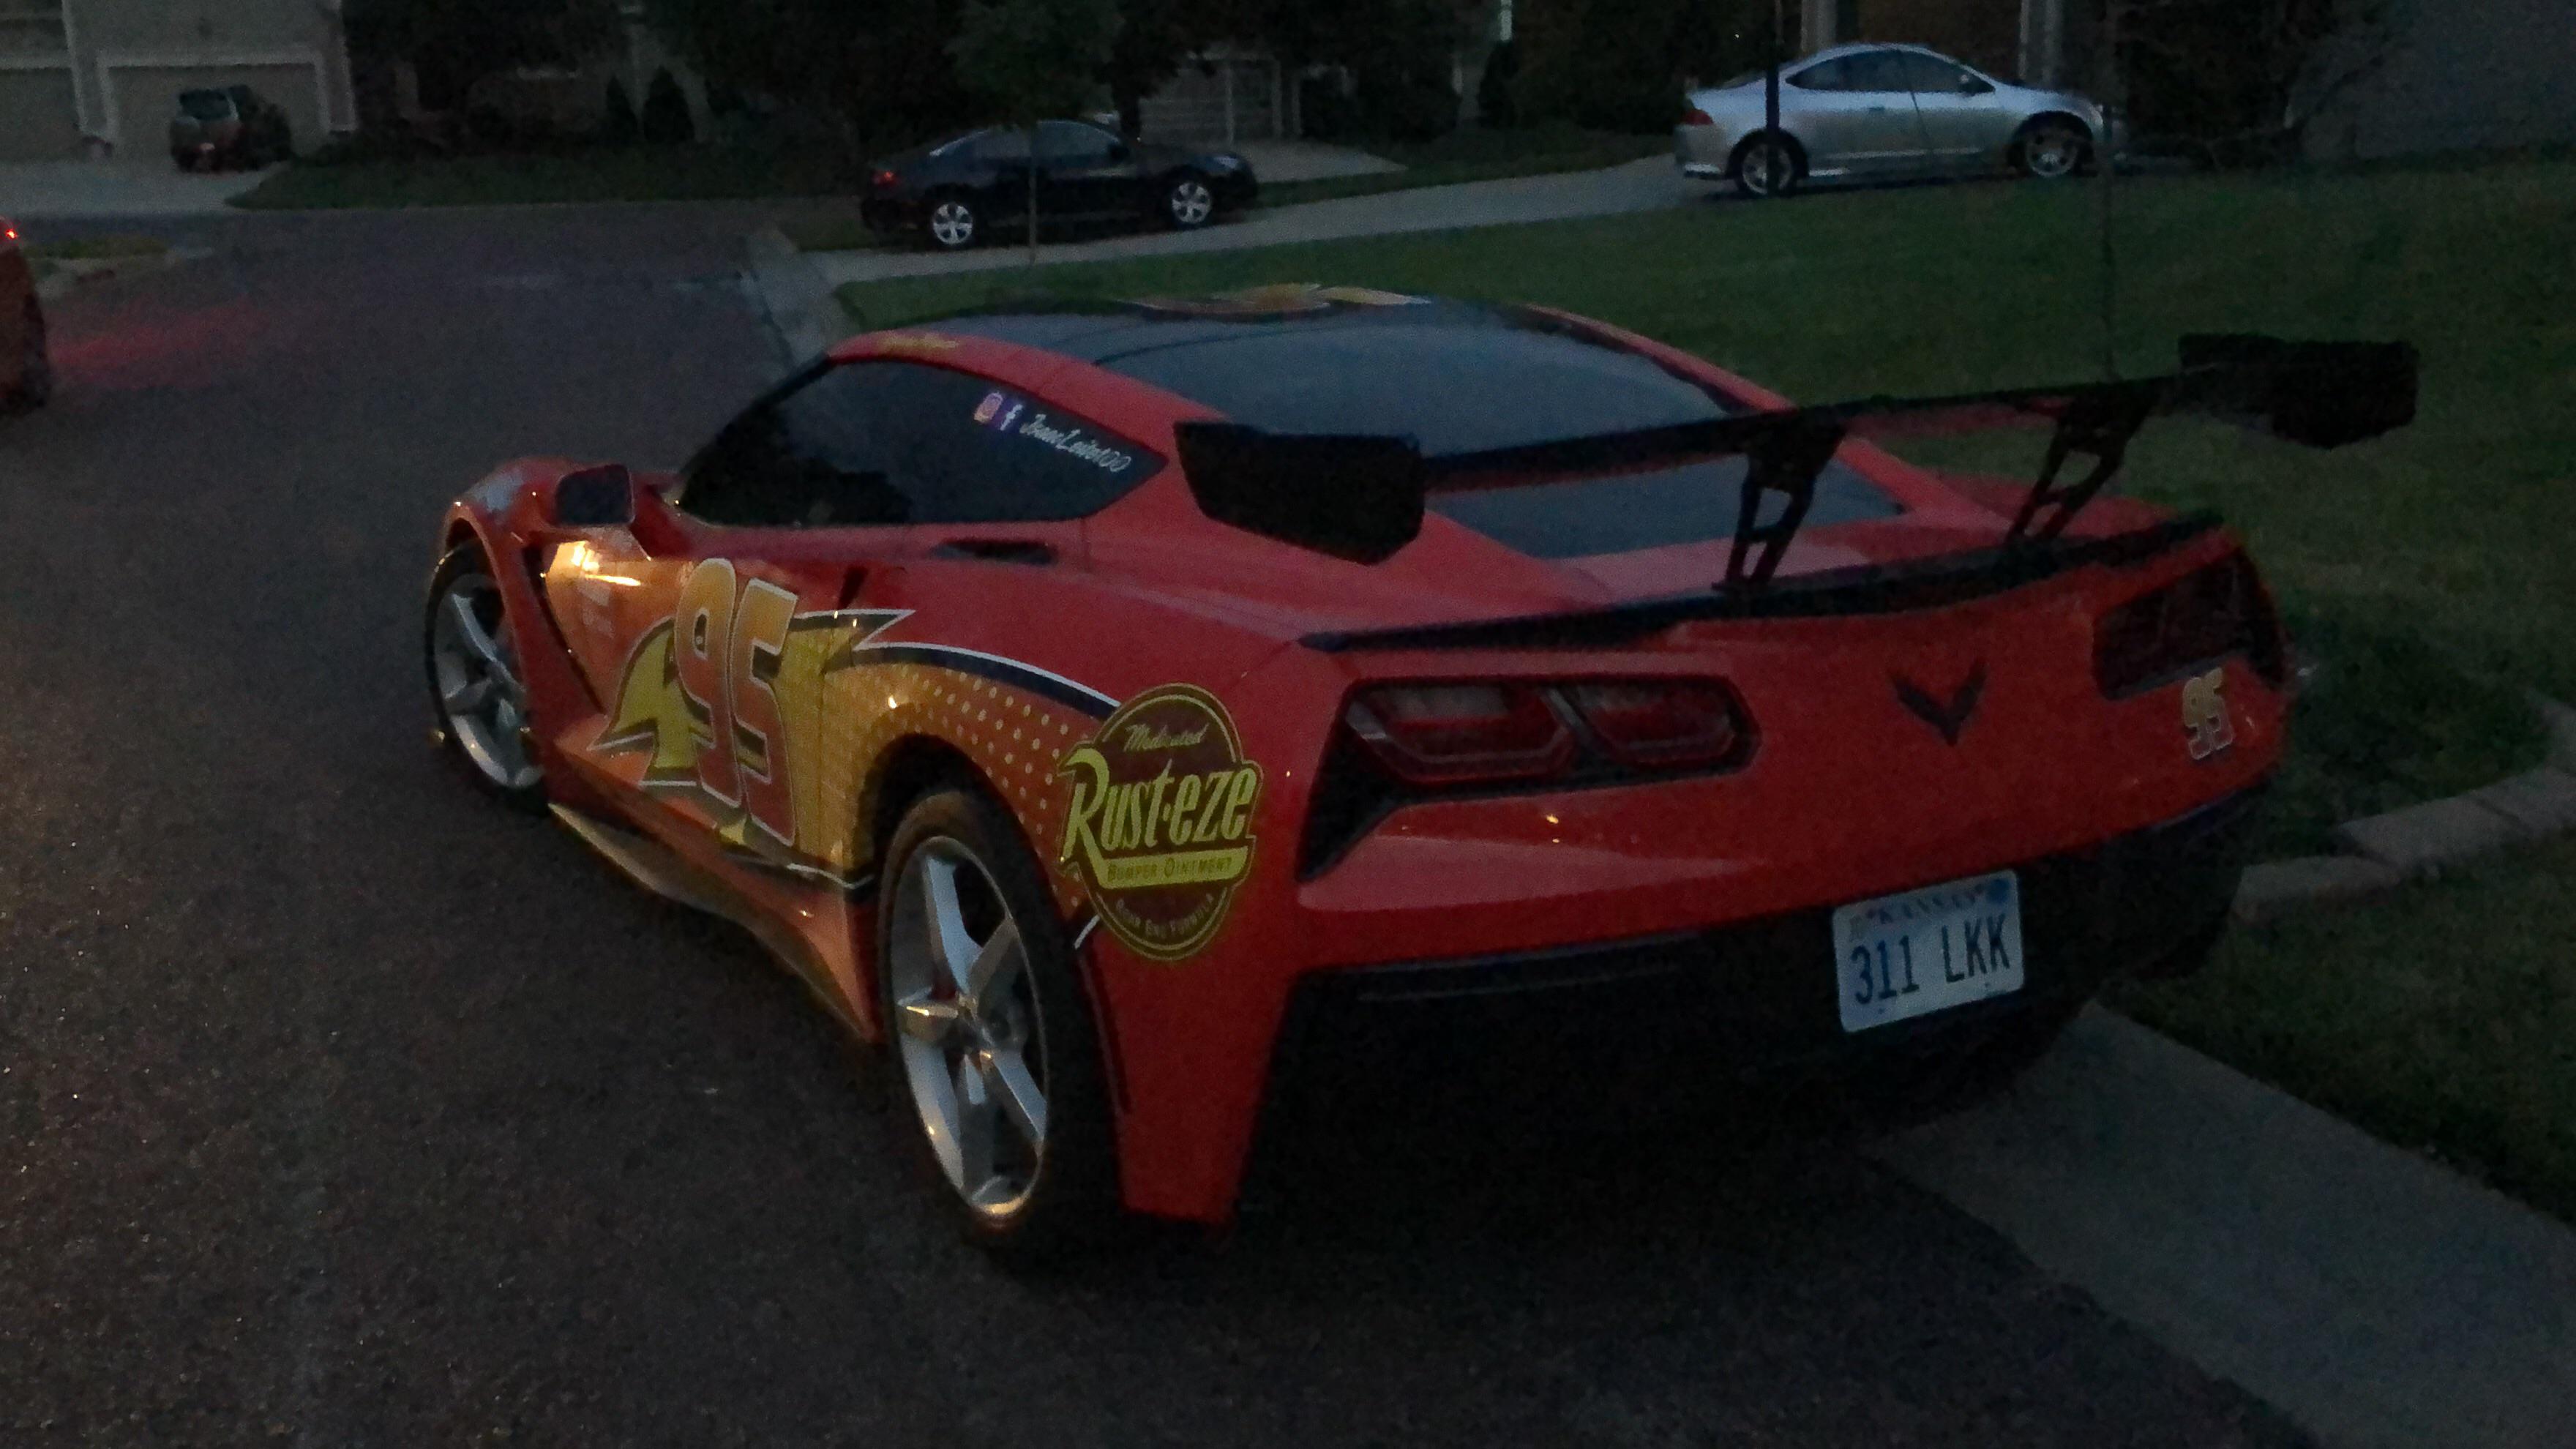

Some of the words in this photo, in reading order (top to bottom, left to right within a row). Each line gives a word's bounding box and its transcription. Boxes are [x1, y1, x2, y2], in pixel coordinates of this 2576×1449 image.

[675, 558, 798, 847] 95
[2182, 667, 2236, 760] 95
[1851, 935, 1920, 1005] 311
[1941, 913, 2010, 984] LKK
